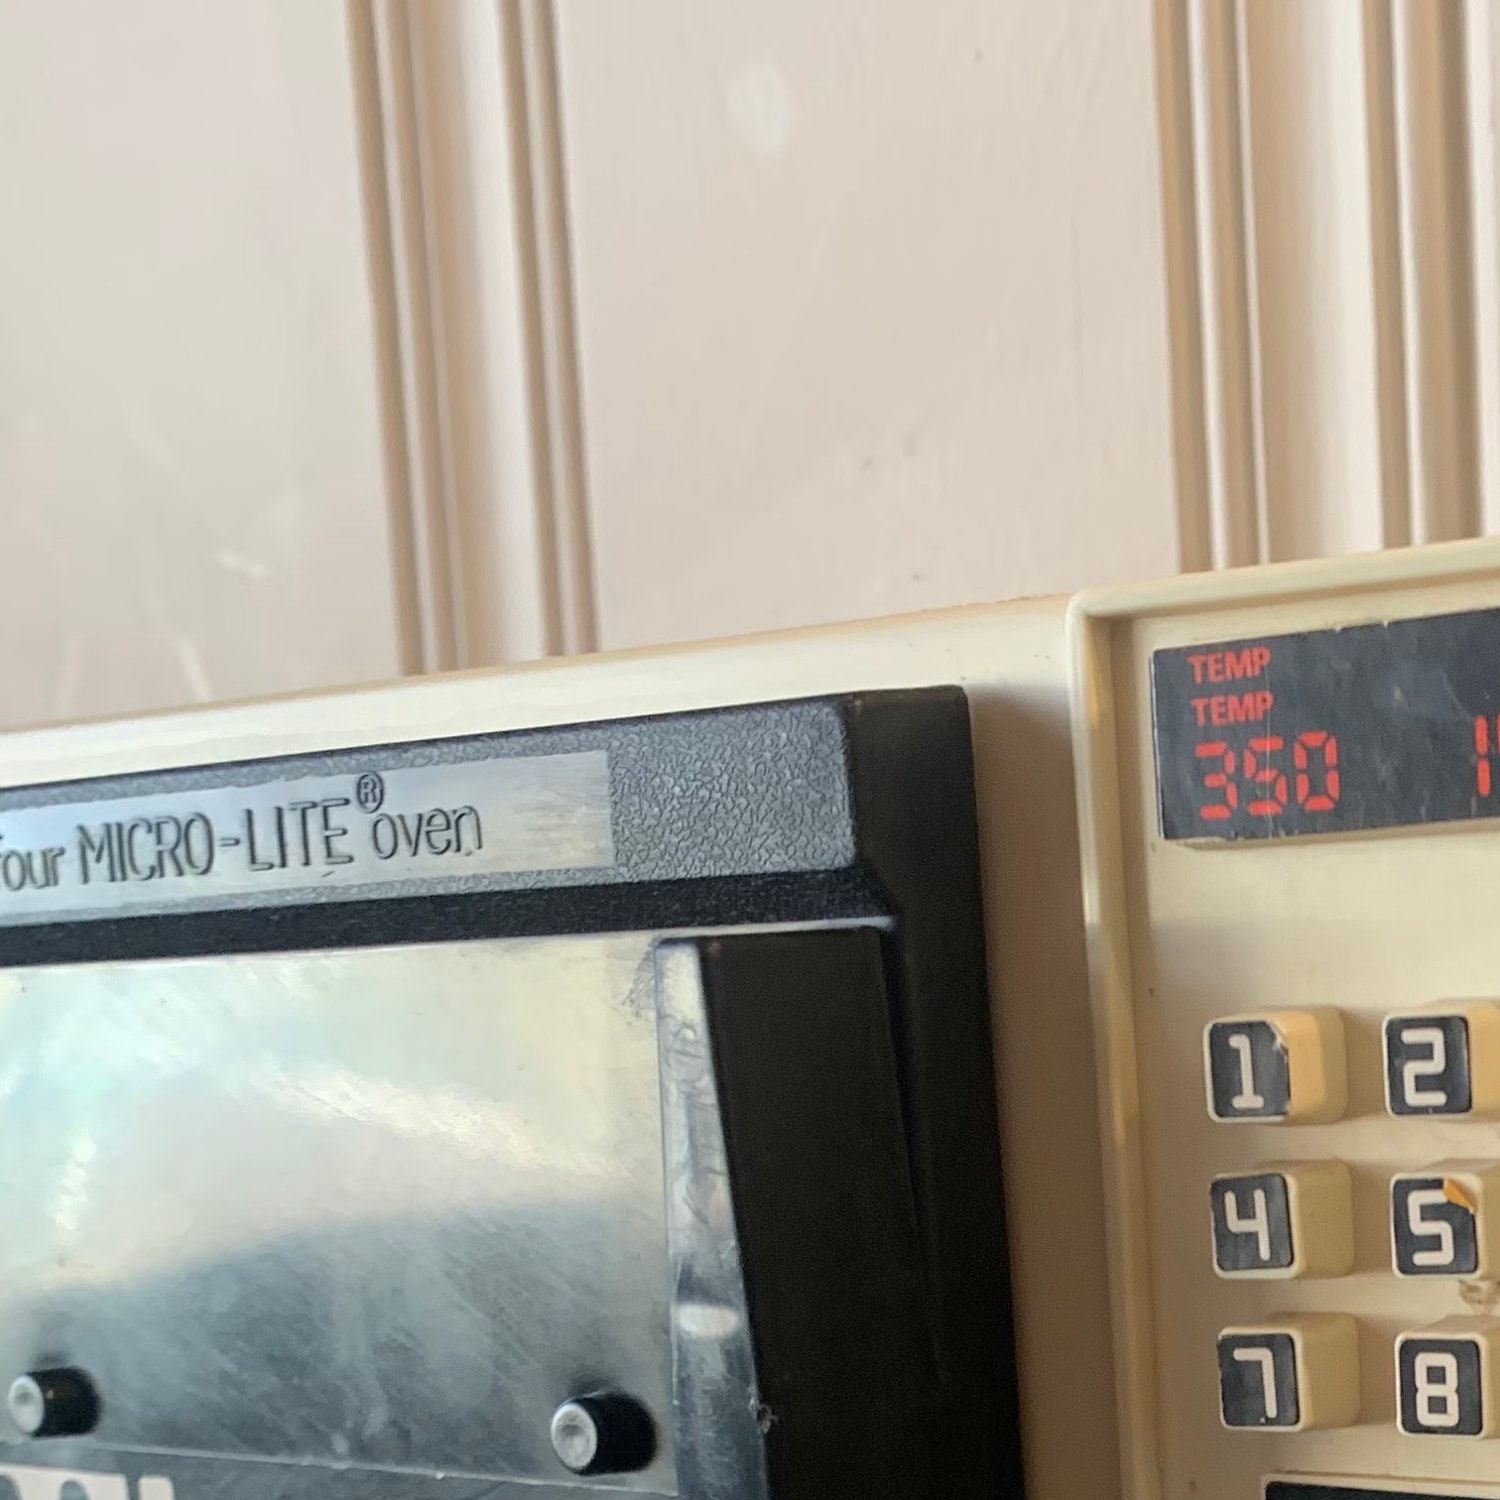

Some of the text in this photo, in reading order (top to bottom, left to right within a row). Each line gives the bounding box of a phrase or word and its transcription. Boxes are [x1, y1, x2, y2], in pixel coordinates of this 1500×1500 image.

[1187, 646, 1271, 684] TEMP
[1190, 691, 1274, 728] TEMP
[1195, 731, 1340, 820] 350
[0, 834, 66, 891] our
[371, 804, 484, 860] oven
[1228, 1034, 1264, 1110] 1
[1401, 1027, 1448, 1107] 2
[1224, 1187, 1272, 1262] 4
[1407, 1188, 1455, 1267] 5
[1232, 1347, 1278, 1420] 7
[1413, 1351, 1460, 1428] 8
